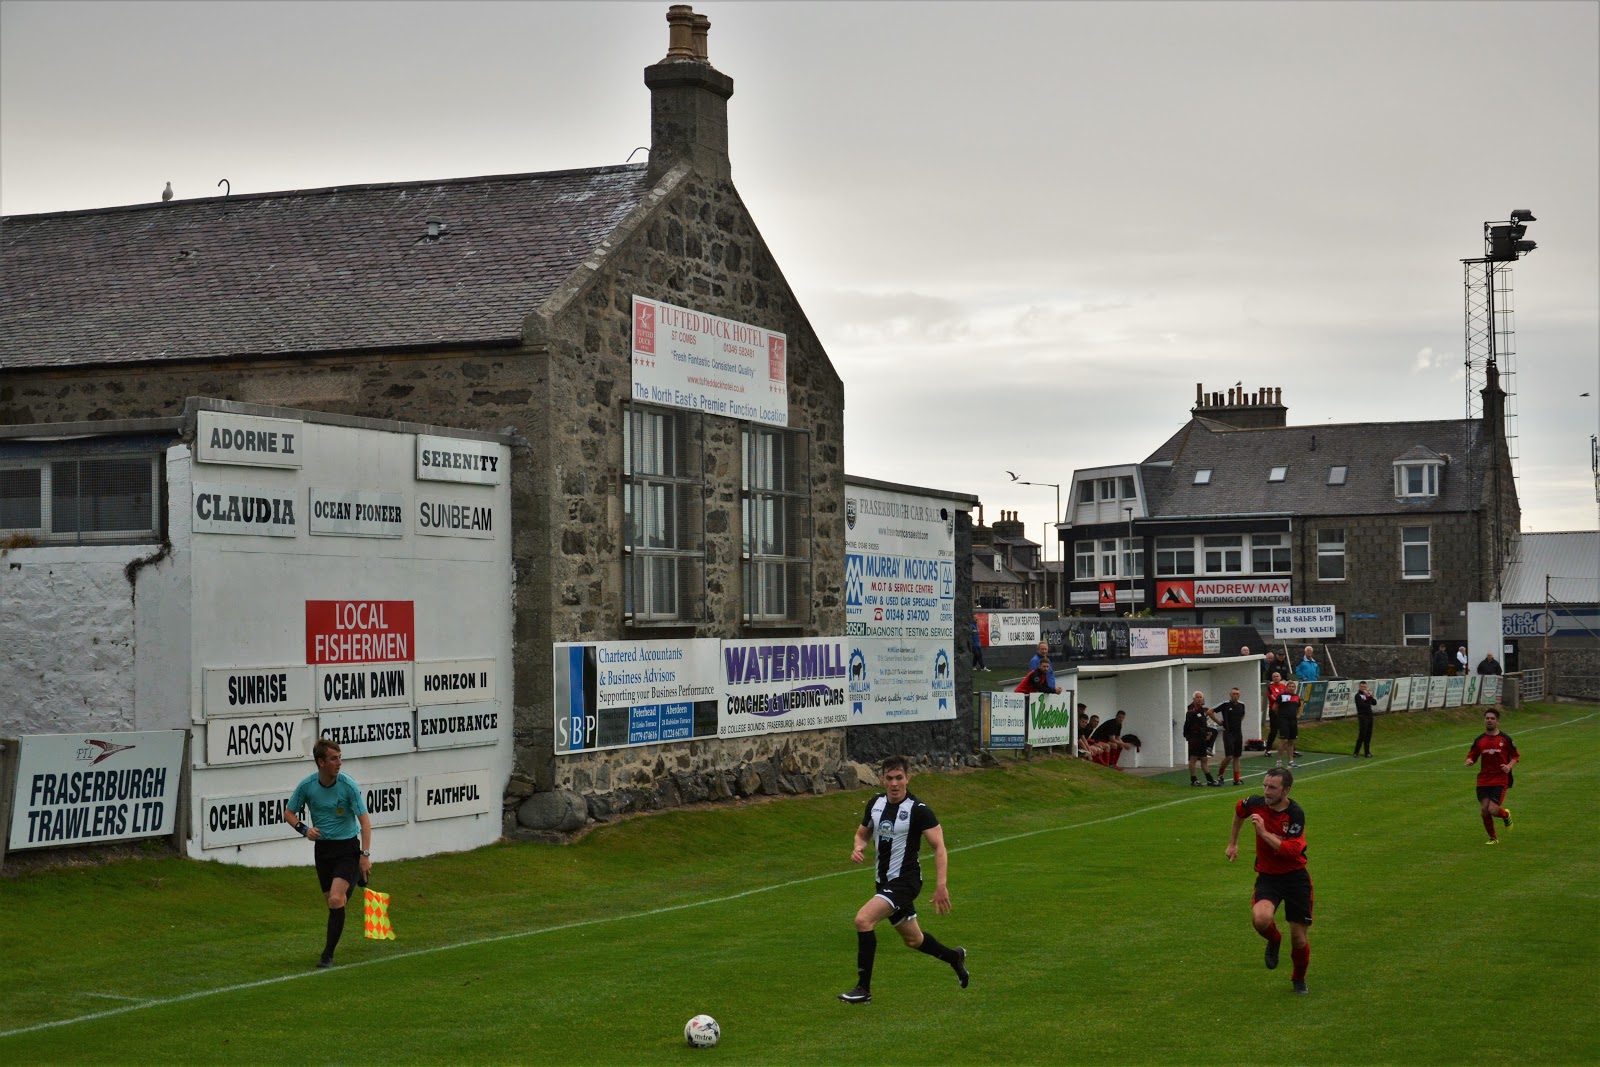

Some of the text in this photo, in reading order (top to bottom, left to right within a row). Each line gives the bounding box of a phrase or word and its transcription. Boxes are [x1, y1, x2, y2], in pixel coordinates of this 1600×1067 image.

[660, 306, 764, 348] TUFTED DUCK HOTEL
[688, 354, 710, 368] Fantastic
[712, 359, 736, 373] Consistent
[635, 382, 786, 423] The North East's Premier Function Location
[210, 427, 294, 454] ADORNE II
[422, 450, 498, 472] SERENITY
[196, 493, 296, 525] CLAUDIA
[314, 500, 402, 523] OCEAN PIONEER
[420, 502, 492, 531] SUNBEAM
[860, 498, 909, 520] FRASERBURGH
[910, 506, 924, 522] CAR
[866, 556, 938, 581] MURRAY MOTORS
[888, 583, 892, 592] &
[894, 583, 914, 593] SERVICE
[916, 584, 933, 594] CENTRE
[1196, 583, 1289, 594] ANDREW MAY
[864, 596, 938, 607] NEW & USED CAR SPECIALIST
[336, 603, 388, 630] LOCAL
[886, 609, 929, 621] 01346 514700
[866, 627, 952, 637] DIAGNOSTIC TESTING SERVICE
[315, 633, 408, 662] FISHERMEN
[599, 647, 682, 664] Chartered Accountants
[724, 644, 846, 685] WATERMILL
[324, 670, 405, 702] OCEAN DAWN
[424, 672, 487, 691] HORIZON II
[600, 668, 675, 686] & Business Advisors
[848, 682, 870, 692] cWILLIAM
[228, 674, 288, 706] SUNRISE
[600, 684, 714, 705] Supporting your Business Performance
[727, 688, 844, 715] COACHES & WEDDING CARS
[633, 706, 656, 717] Peterhead
[666, 704, 687, 715] Aberdeen
[320, 721, 411, 745] CHALLENGER
[420, 713, 498, 736] ENDURANCE
[720, 726, 726, 734] 88
[728, 724, 746, 734] COLLEGE
[226, 721, 294, 756] ARGOSY
[631, 732, 643, 741] 01779
[30, 767, 167, 806] FRASERBURGH
[426, 784, 480, 806] FAITHFUL
[366, 787, 402, 814] QUEST
[28, 801, 164, 843] TRAWLERS LTD
[209, 798, 306, 832] OCEAN REAR
